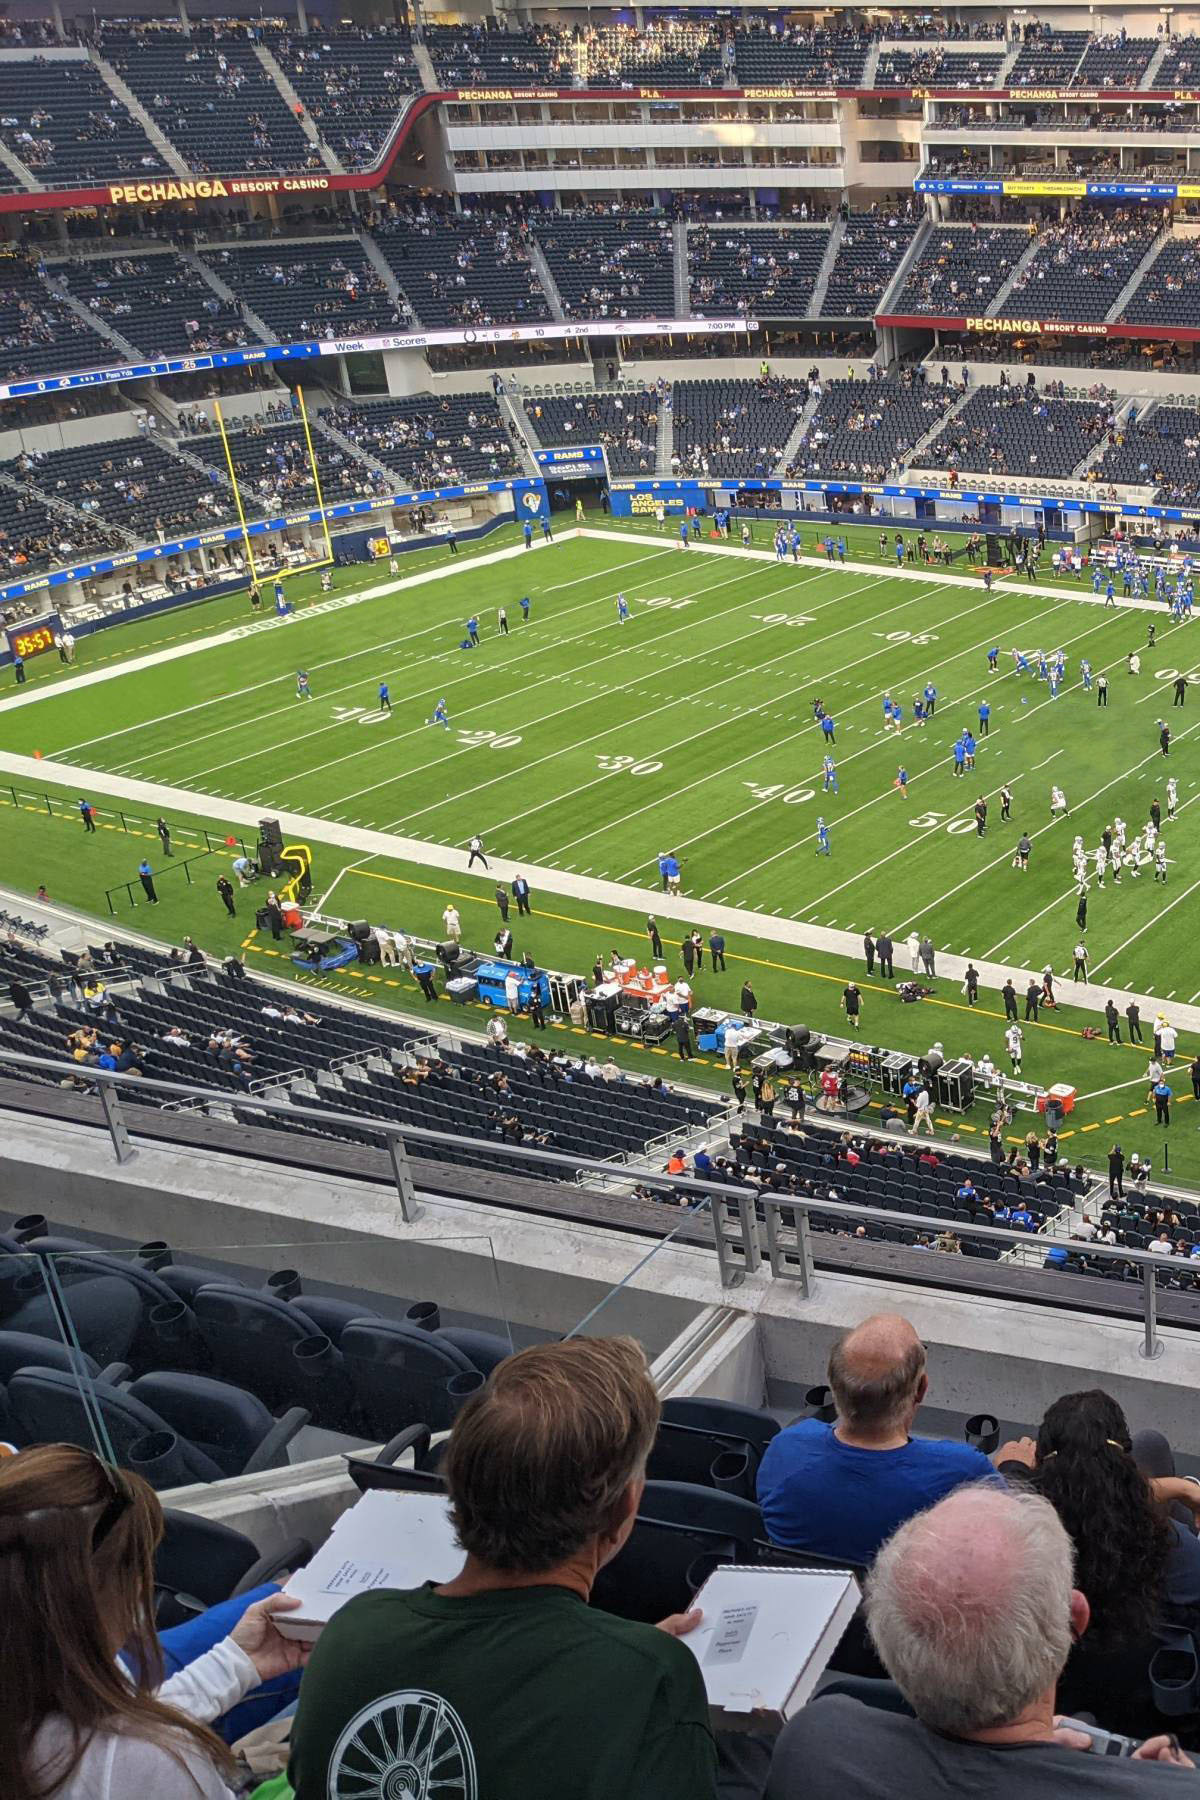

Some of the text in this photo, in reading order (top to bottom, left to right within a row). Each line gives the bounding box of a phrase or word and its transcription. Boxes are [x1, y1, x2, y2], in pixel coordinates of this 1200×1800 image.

[458, 90, 512, 100] PECHANGA
[744, 89, 794, 98] PECHANGA
[1010, 90, 1058, 99] PECHANGA
[110, 179, 329, 204] PECHANGA RESORT CASINO
[575, 326, 588, 334] 2nd
[707, 322, 723, 330] 7:00
[966, 318, 1108, 334] PECHANGA RESORT CASINO
[335, 336, 427, 351] Week Scores
[243, 351, 266, 360] RAMS
[554, 451, 584, 460] RAMS
[463, 484, 488, 494] RAMS
[698, 481, 722, 489] RAMS
[782, 481, 805, 489] RAMS
[861, 486, 884, 494] RAMS
[630, 493, 653, 501] LOS
[940, 492, 962, 500] RAMS
[370, 498, 395, 509] RAMS
[631, 499, 684, 507] ANGELES
[1019, 498, 1042, 506] RAMS
[1099, 504, 1122, 512] RAMS
[286, 514, 310, 525] RAMS
[199, 533, 225, 545] RAMS
[112, 555, 138, 567] RAMS
[24, 579, 50, 592] RAMS
[15, 627, 52, 656] 35:57
[598, 755, 664, 775] 30
[751, 783, 816, 804] 40
[909, 811, 979, 833] 50
[788, 1090, 799, 1101] 28
